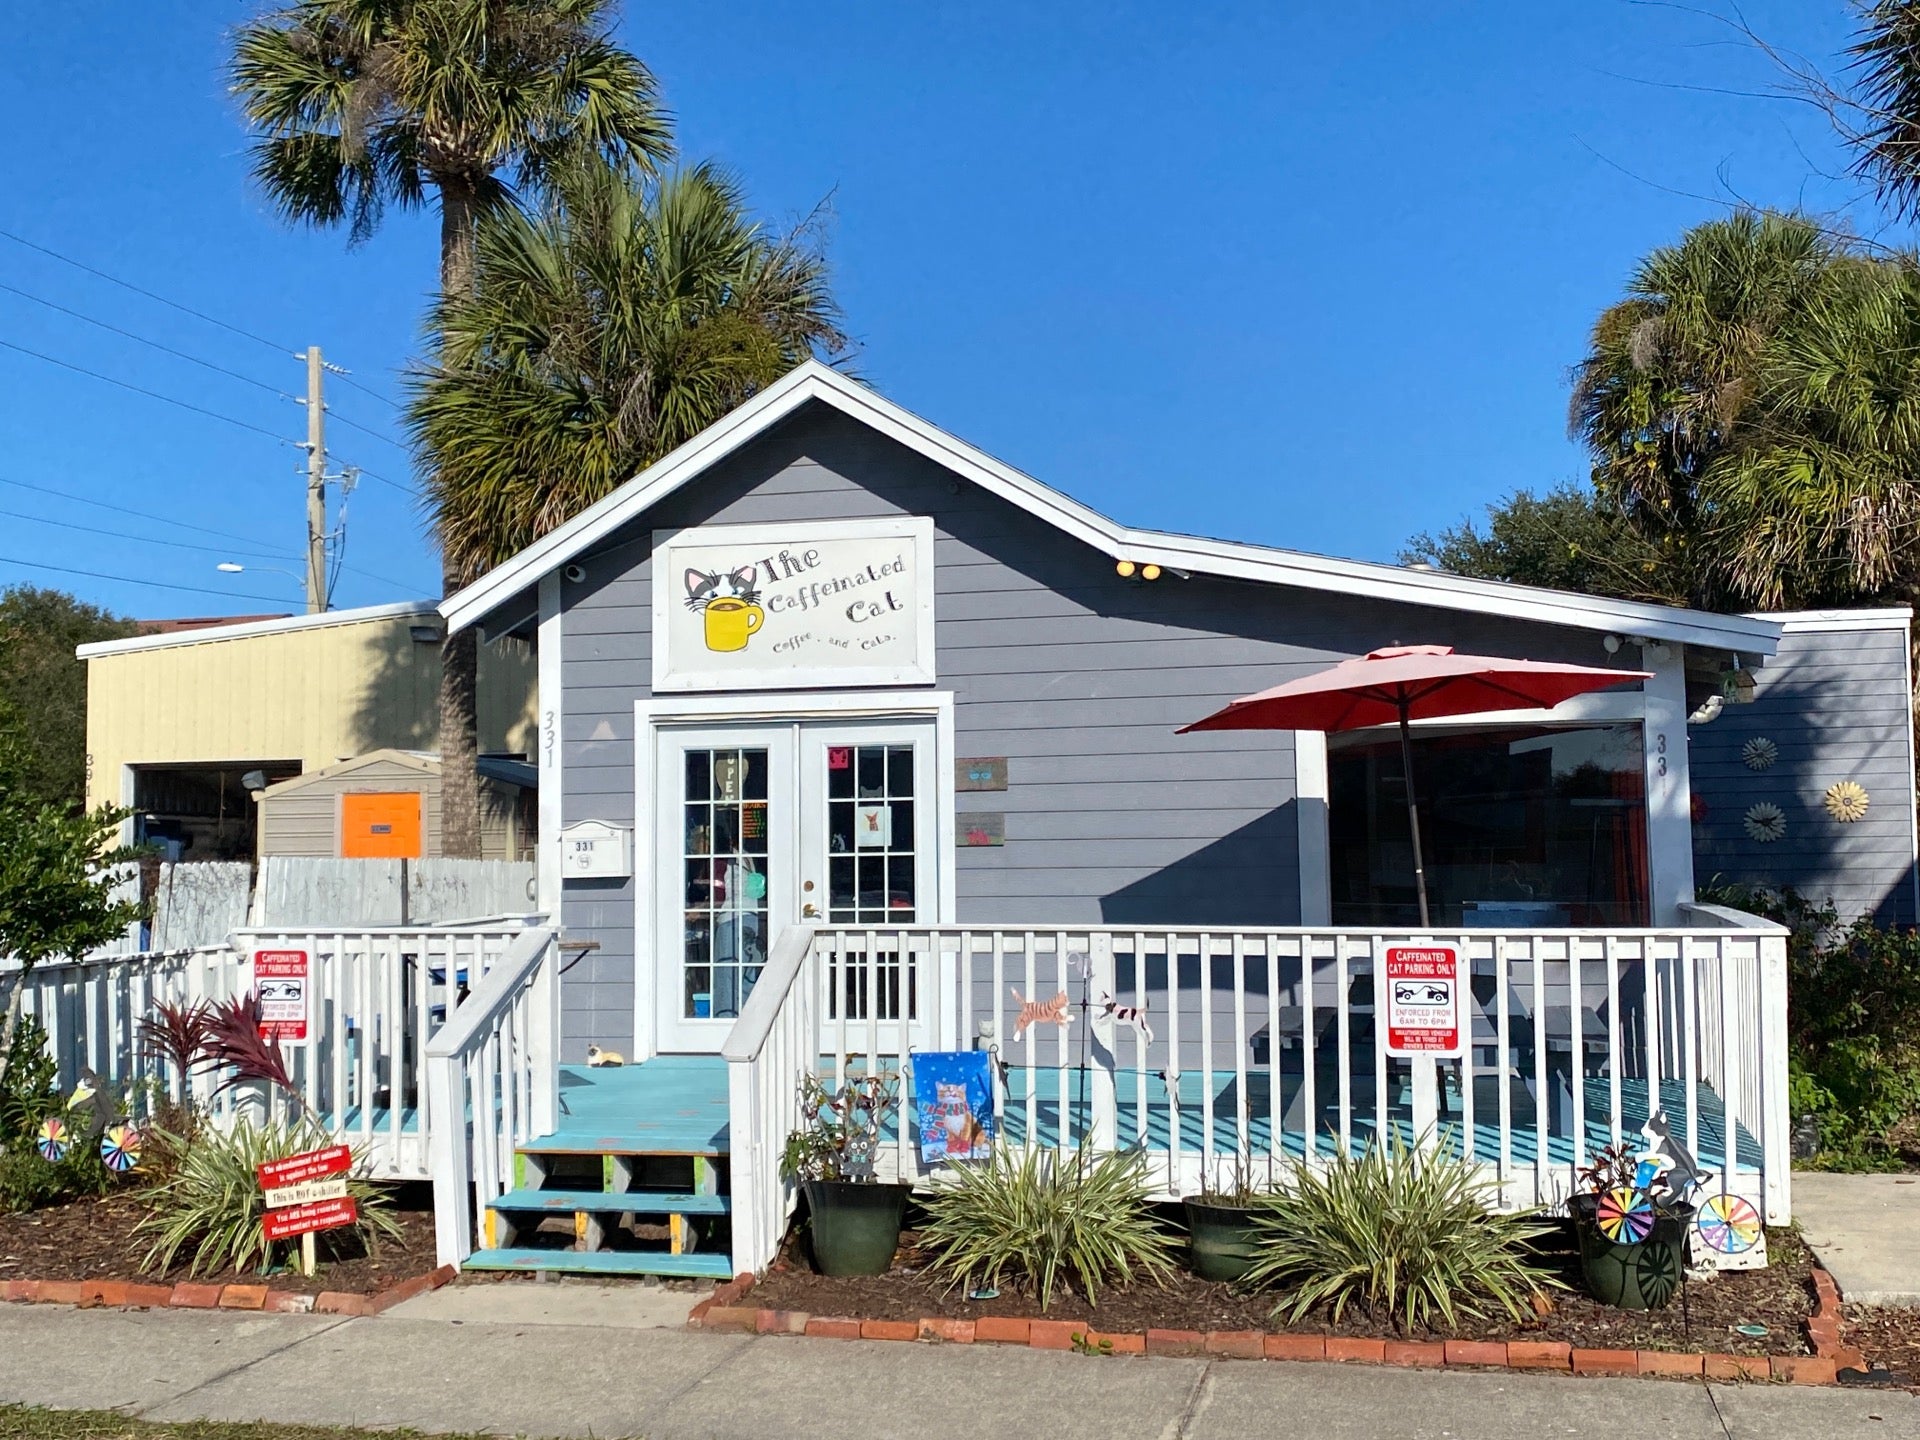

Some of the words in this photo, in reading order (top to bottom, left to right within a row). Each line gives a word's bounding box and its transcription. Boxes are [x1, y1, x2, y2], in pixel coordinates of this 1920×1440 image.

[755, 549, 822, 584] The
[767, 554, 906, 613] Caffeinated
[845, 590, 904, 623] Cat
[828, 636, 850, 649] and
[543, 711, 556, 768] 331
[575, 842, 594, 851] 331
[255, 963, 267, 974] CAT
[267, 963, 291, 974] PARKING
[1388, 963, 1402, 974] CAT
[1404, 963, 1435, 975] PARKING
[1436, 964, 1455, 975] ONLY
[1395, 1008, 1431, 1017] ENFORCED
[1432, 1009, 1451, 1017] FROM
[1399, 1017, 1416, 1025] 6AM
[1430, 1017, 1447, 1025] 6PM
[263, 1166, 275, 1175] The
[273, 1193, 287, 1203] This
[276, 1214, 289, 1223] You
